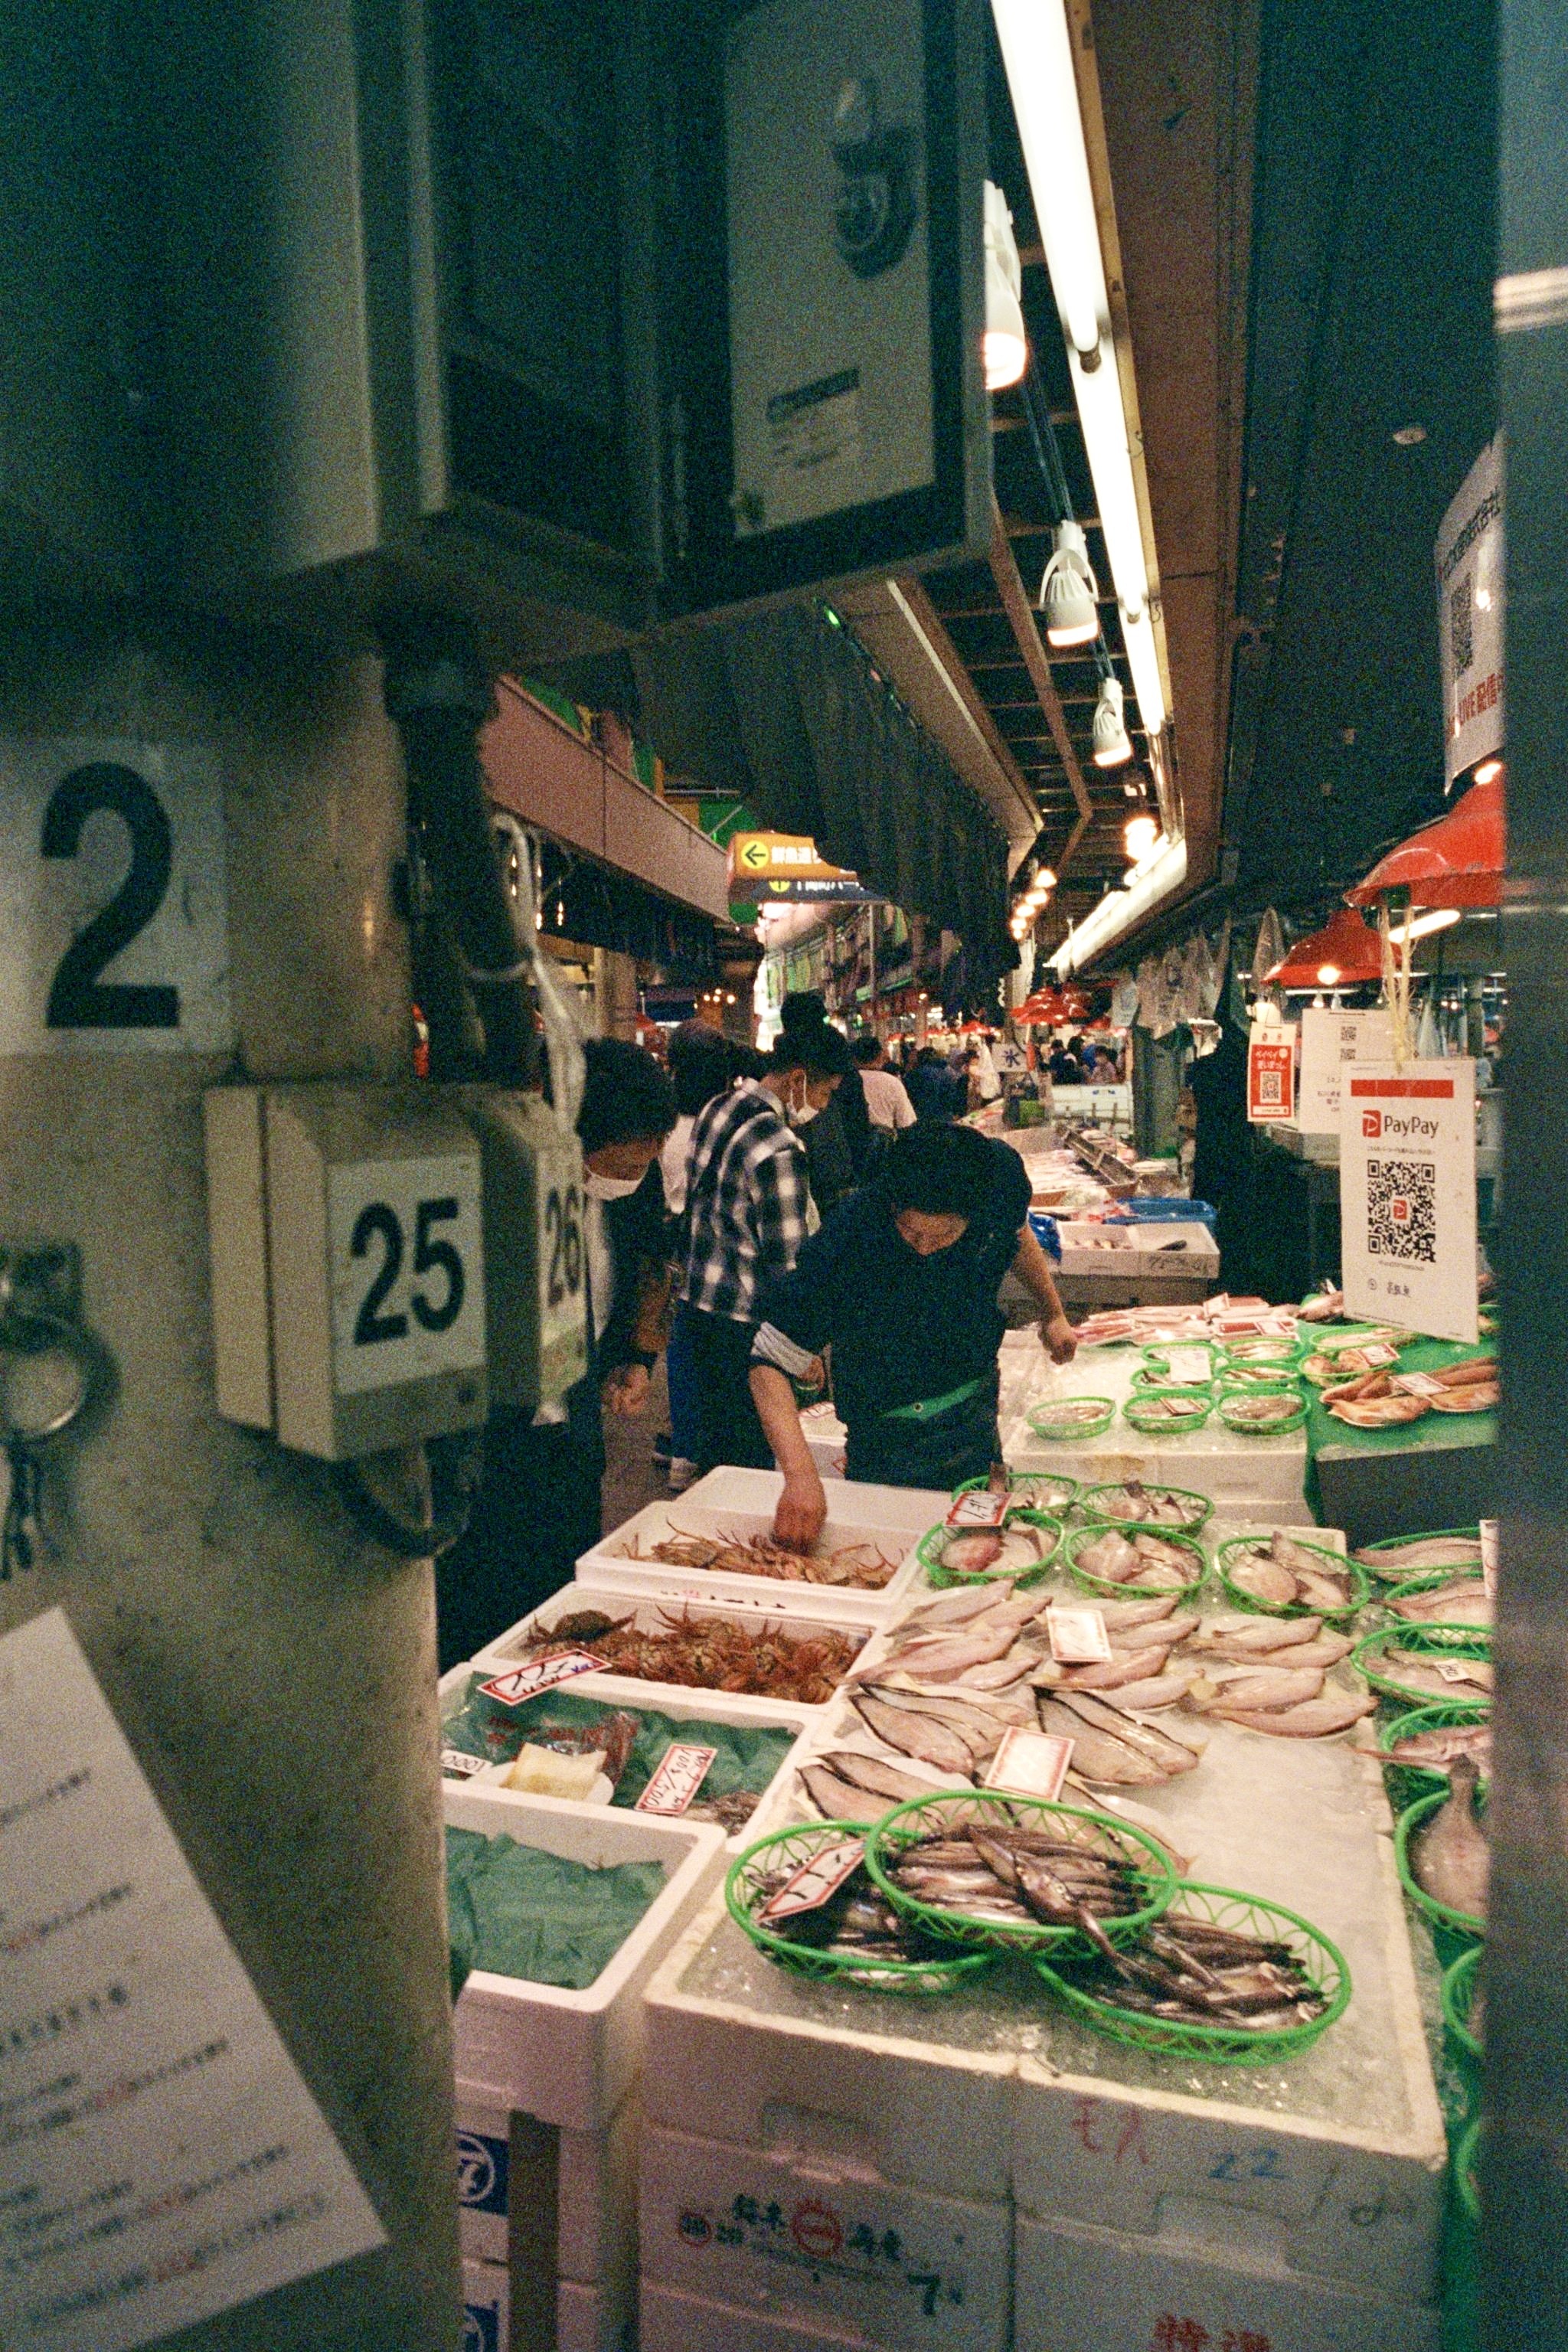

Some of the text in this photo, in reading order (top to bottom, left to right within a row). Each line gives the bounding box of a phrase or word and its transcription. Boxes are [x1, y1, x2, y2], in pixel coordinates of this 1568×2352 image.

[41, 761, 180, 1028] 2
[1383, 1115, 1439, 1139] PayPay
[351, 1197, 465, 1346] 25
